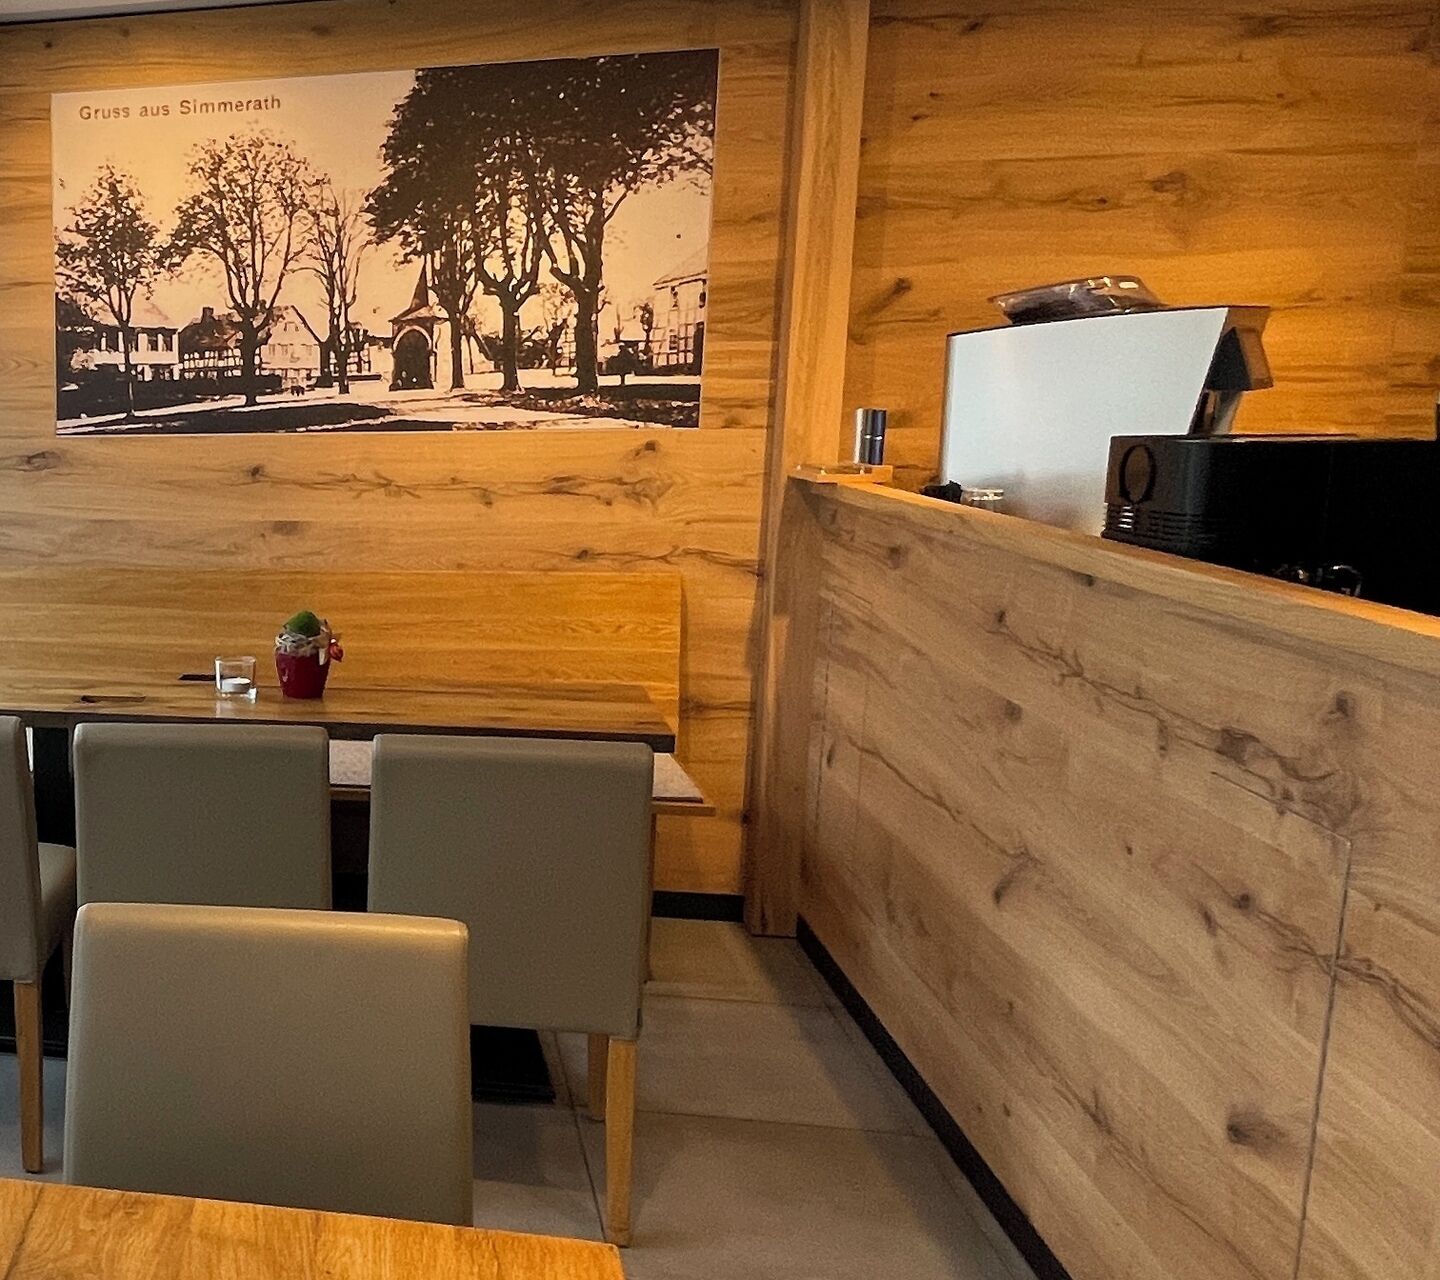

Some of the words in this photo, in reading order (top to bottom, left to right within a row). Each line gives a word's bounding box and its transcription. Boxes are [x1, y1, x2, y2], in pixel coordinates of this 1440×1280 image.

[79, 105, 131, 121] Gruss
[139, 103, 170, 118] aus
[179, 95, 282, 116] Simmerath
